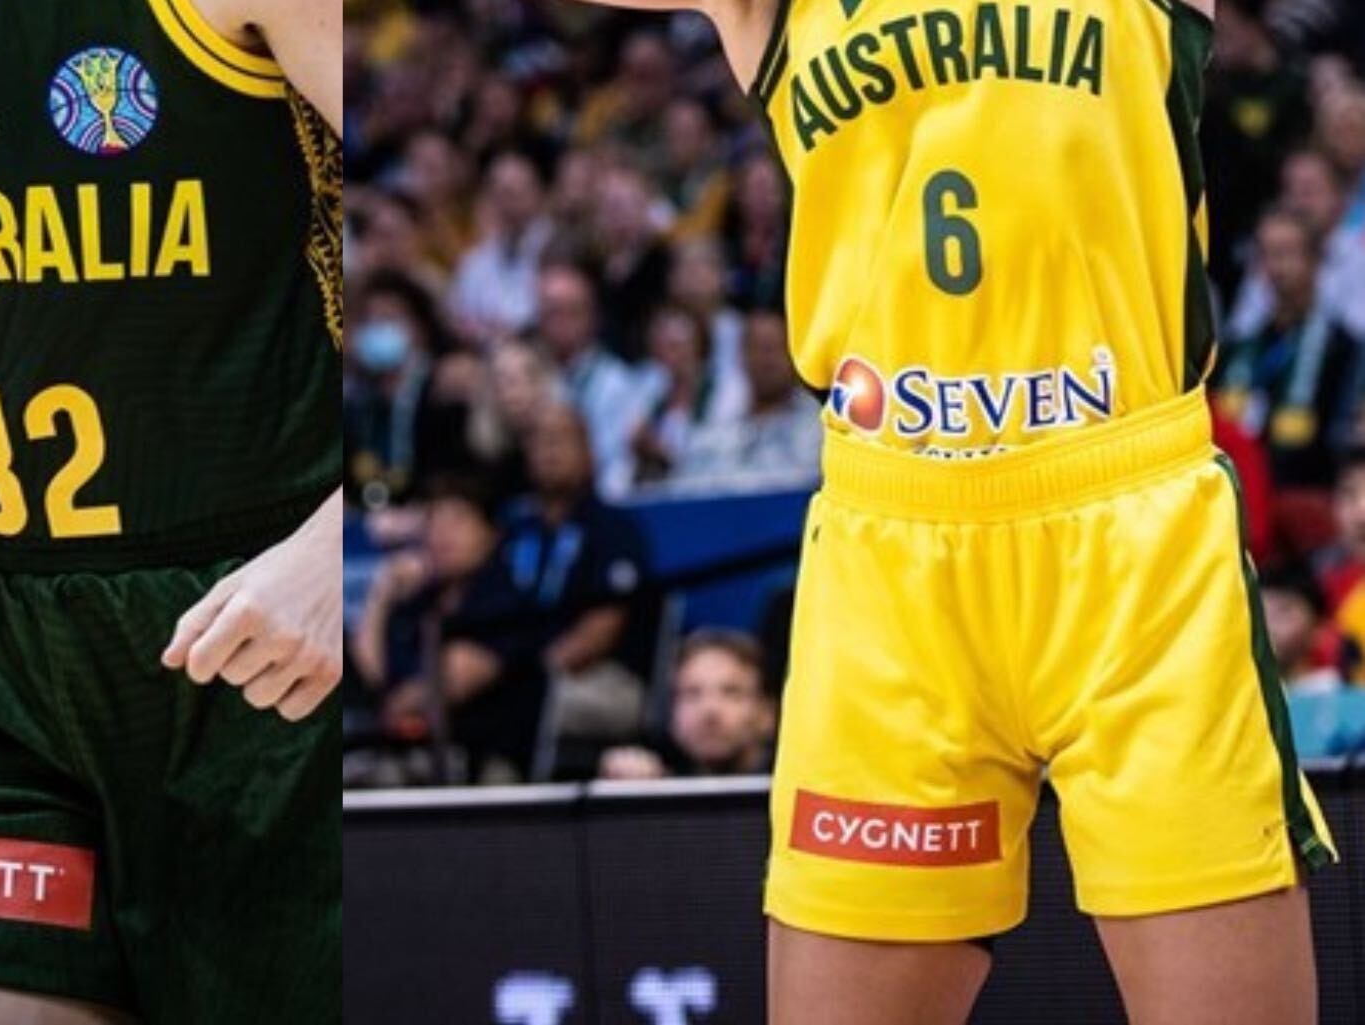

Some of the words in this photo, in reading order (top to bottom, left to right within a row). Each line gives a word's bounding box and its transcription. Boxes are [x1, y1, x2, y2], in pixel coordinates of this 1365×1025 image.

[789, 1, 1105, 152] AUSTRALIA
[922, 169, 983, 297] 6
[894, 368, 1112, 435] SEVEN
[811, 810, 983, 852] CYGNETT
